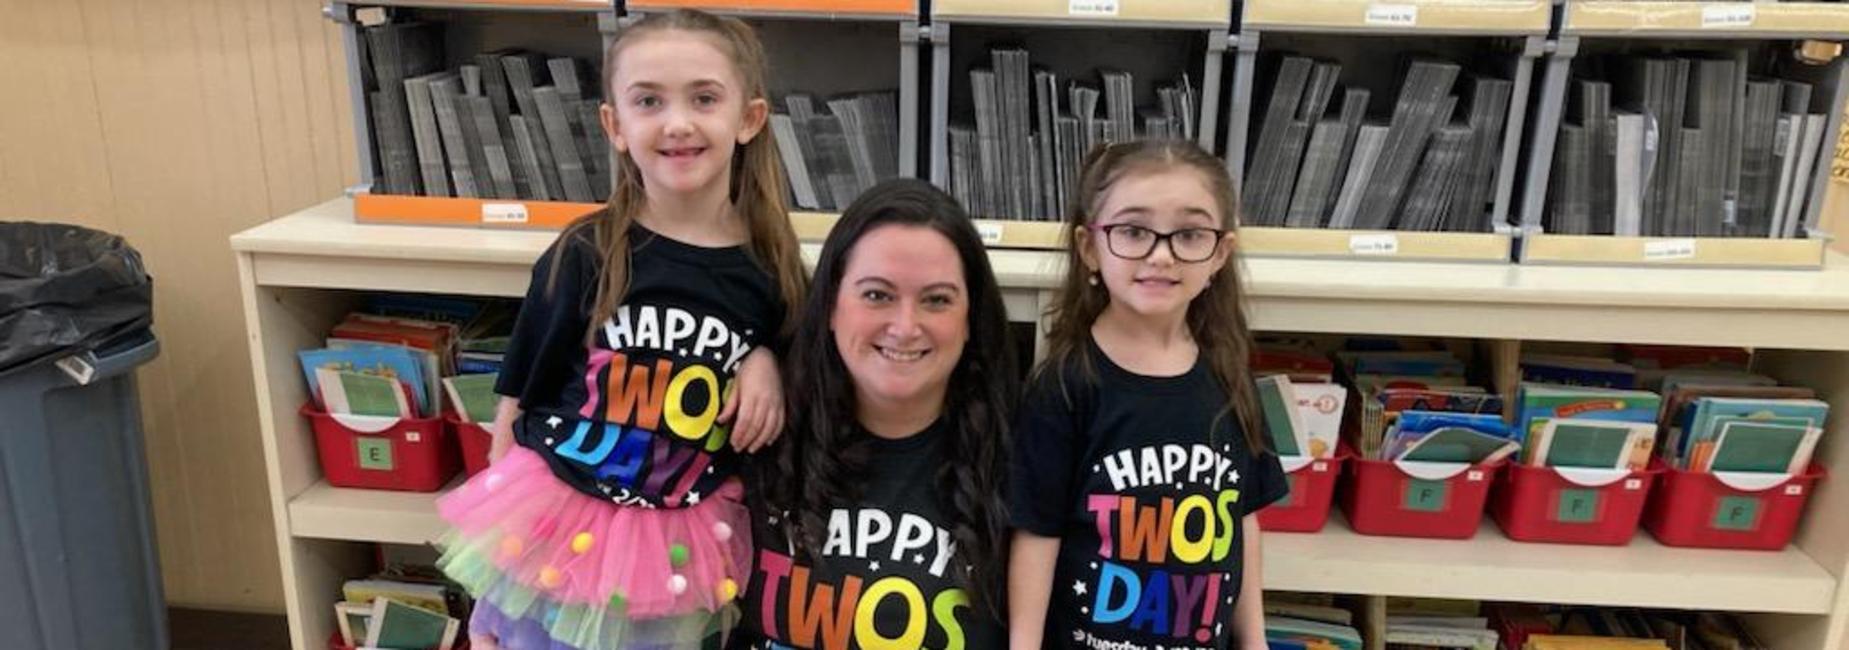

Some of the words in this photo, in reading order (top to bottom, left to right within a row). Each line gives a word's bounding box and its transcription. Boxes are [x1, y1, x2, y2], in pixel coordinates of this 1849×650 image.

[604, 305, 751, 373] HAPPY
[369, 447, 381, 461] E
[1103, 444, 1232, 491] HAPPY
[783, 508, 957, 577] APPY
[1087, 489, 1240, 564] TWOS
[758, 548, 972, 650] TWOS
[1093, 562, 1222, 643] DAY!
